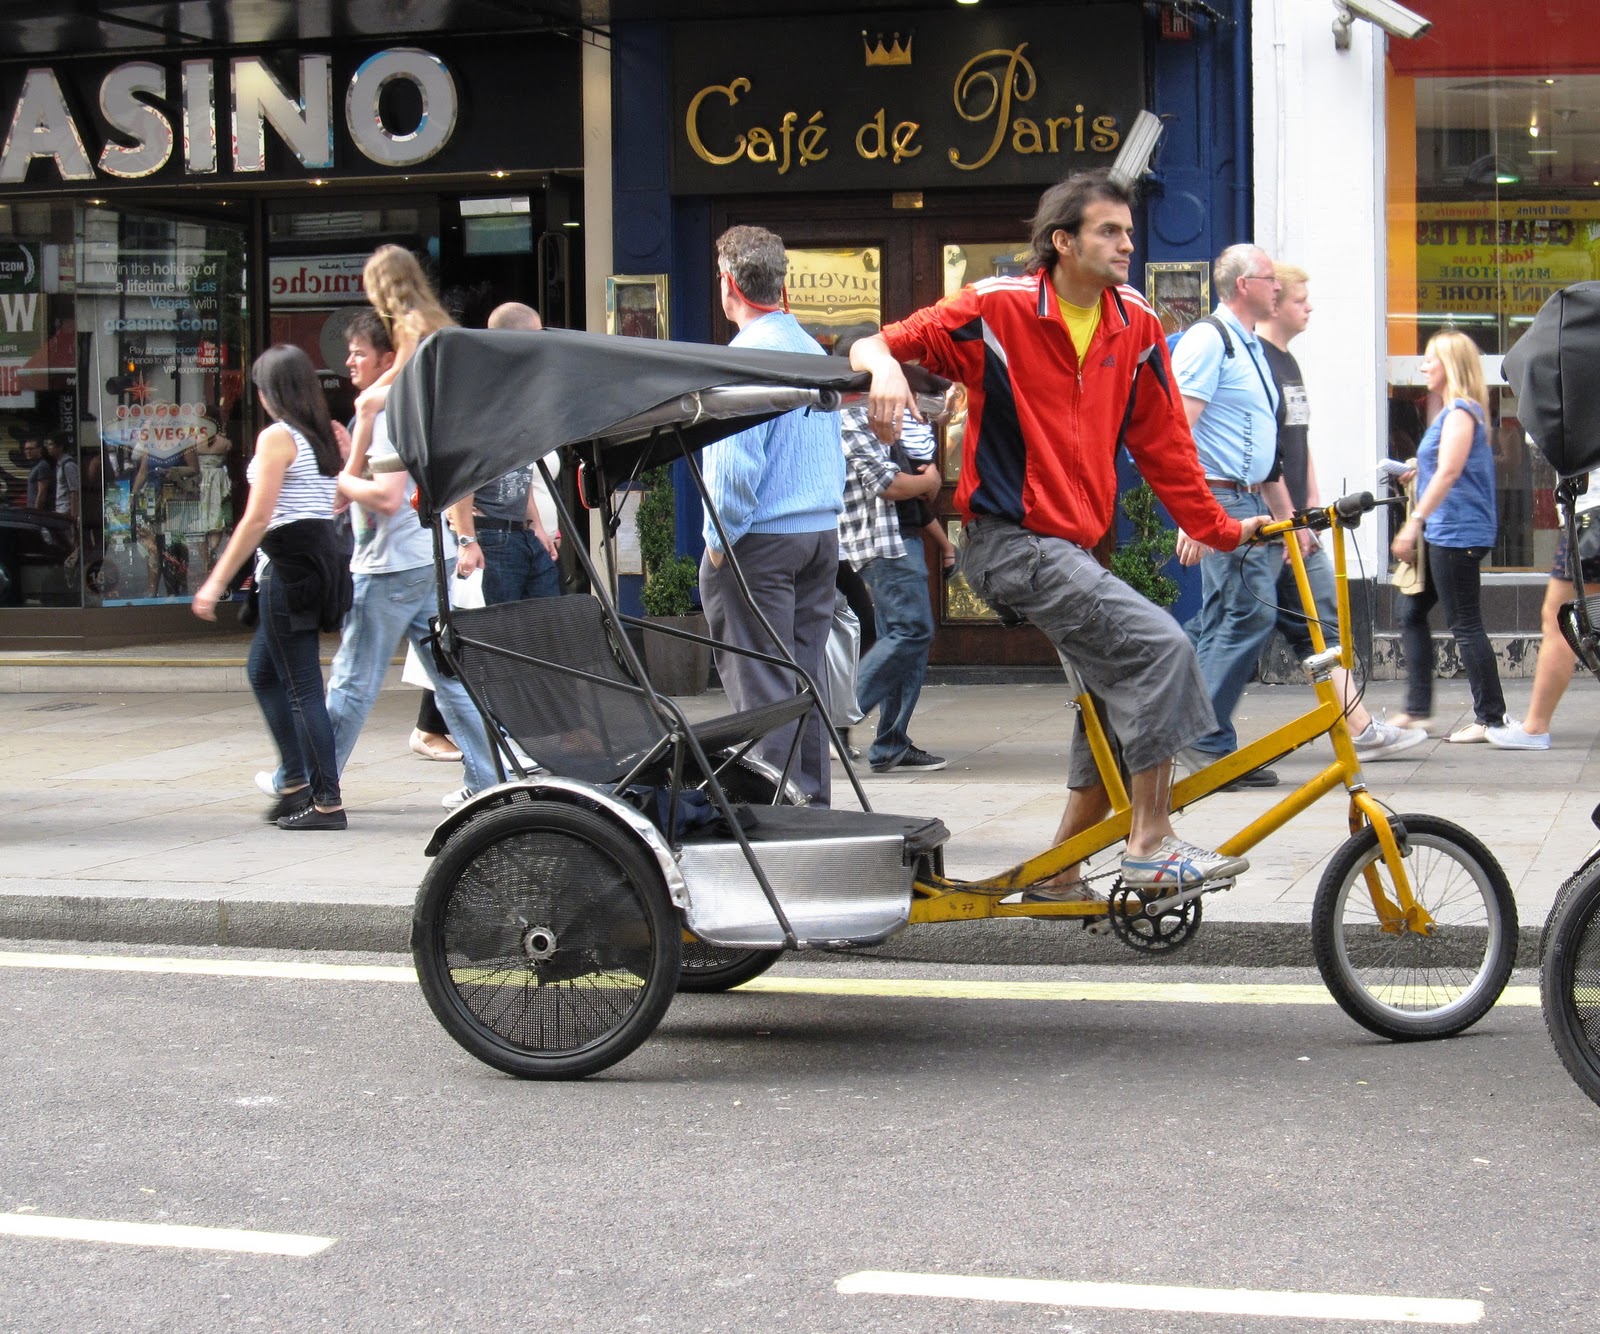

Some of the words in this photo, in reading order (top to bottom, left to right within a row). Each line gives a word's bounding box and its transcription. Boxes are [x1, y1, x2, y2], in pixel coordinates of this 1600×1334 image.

[0, 47, 459, 183] ASINO
[686, 77, 829, 175] Café
[855, 108, 922, 164] de
[948, 42, 1121, 170] Paris
[103, 263, 128, 275] Win
[131, 263, 150, 275] the
[153, 262, 200, 277] holiday
[203, 263, 217, 275] of
[115, 282, 124, 292] a
[127, 279, 175, 292] lifetime
[177, 281, 190, 292] to
[193, 280, 217, 292] Las
[150, 296, 190, 312] Vegas
[193, 296, 217, 309] with
[103, 316, 218, 336] gcasino.com
[163, 366, 176, 374] VIP
[178, 366, 219, 375] experience
[121, 428, 149, 441] LAS
[154, 426, 208, 441] VEGAS
